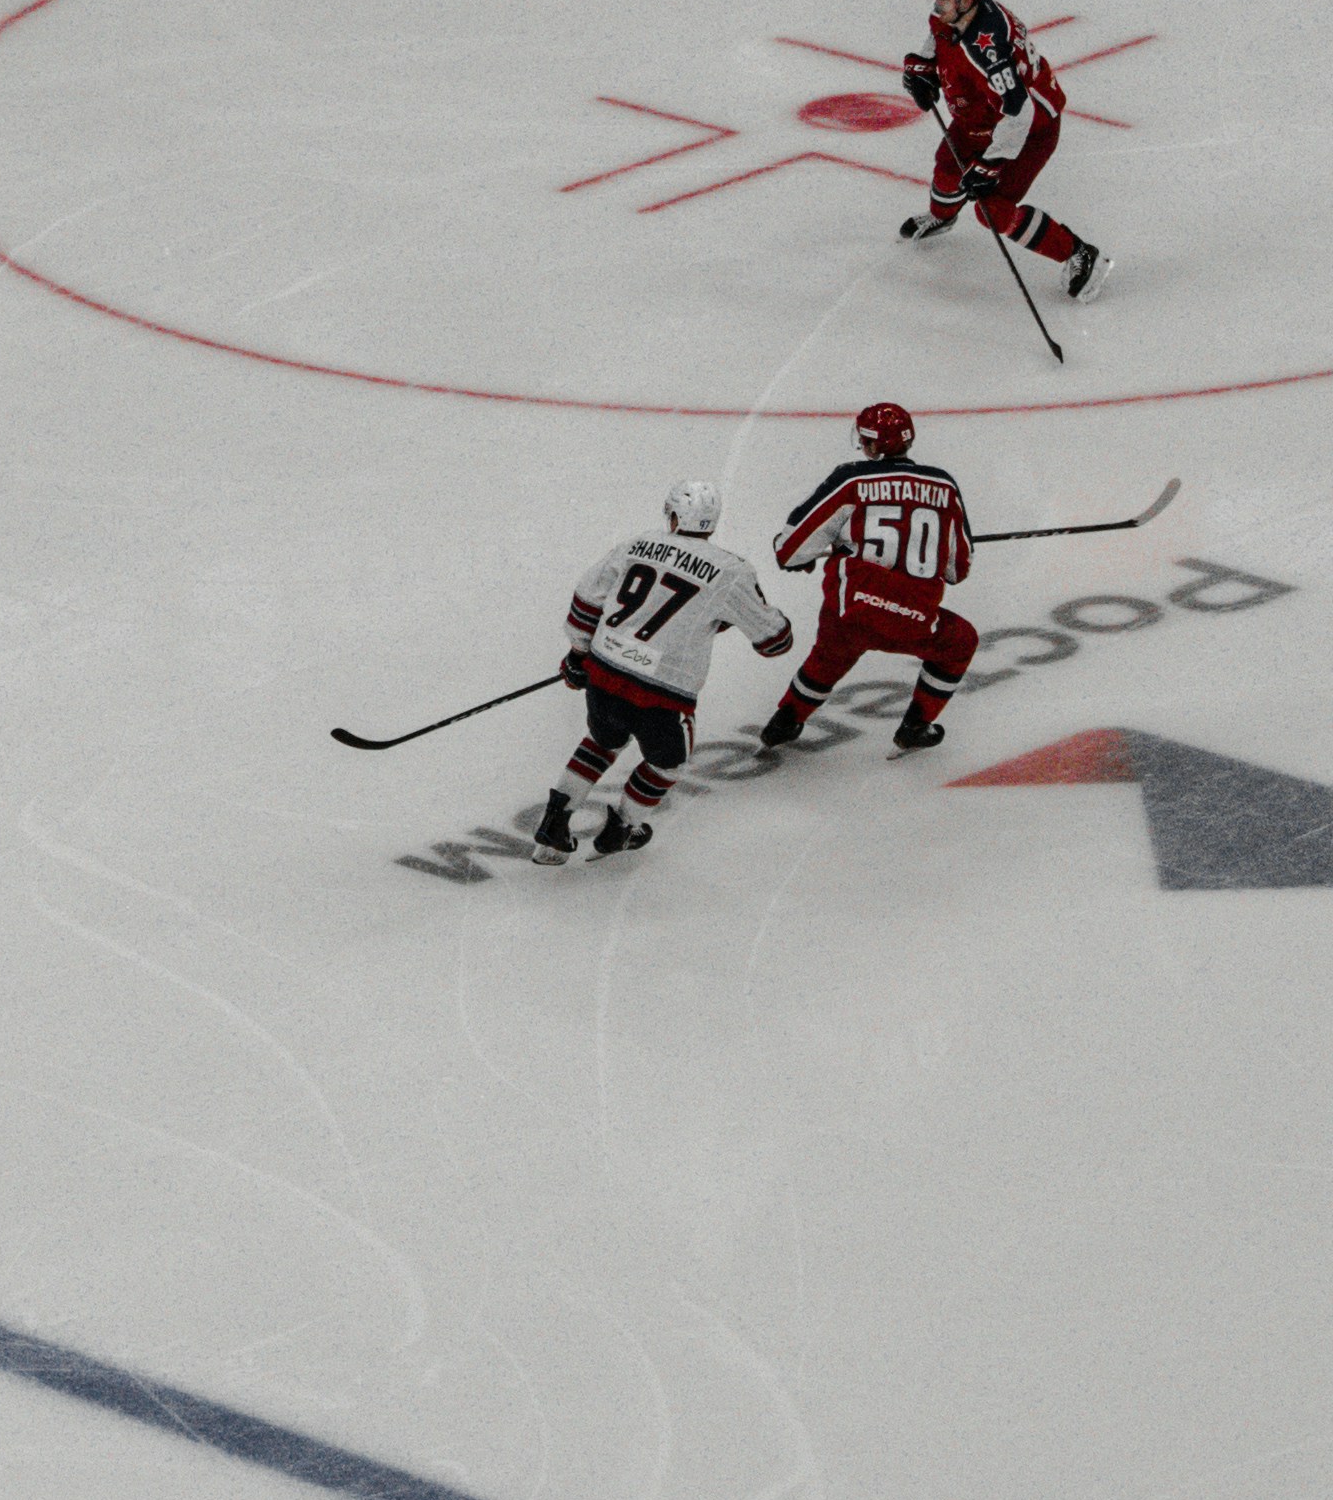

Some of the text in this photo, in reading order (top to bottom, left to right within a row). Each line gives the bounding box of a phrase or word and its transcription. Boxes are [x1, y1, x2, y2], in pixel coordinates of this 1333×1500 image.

[858, 481, 949, 508] YURTAIKIN
[628, 540, 720, 584] SHARIFYANOV
[862, 505, 941, 579] 50
[606, 563, 700, 642] 97
